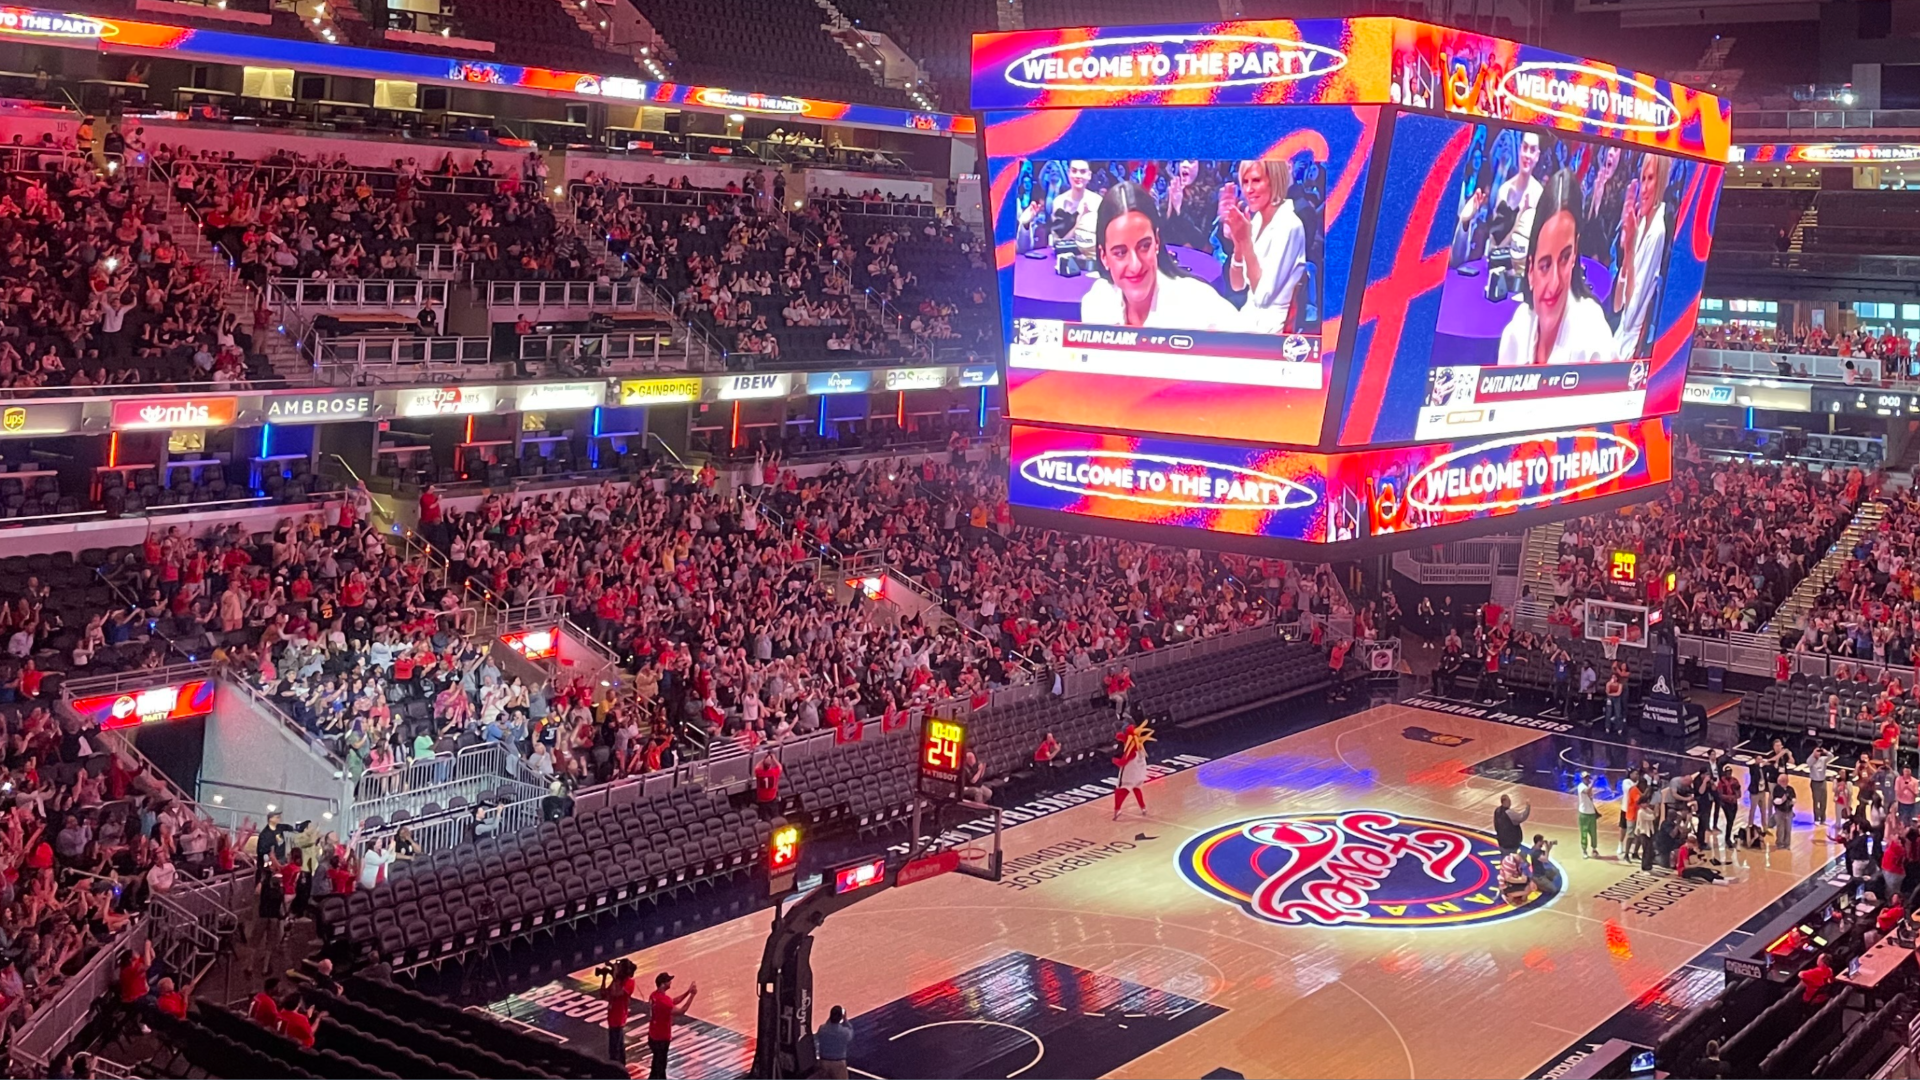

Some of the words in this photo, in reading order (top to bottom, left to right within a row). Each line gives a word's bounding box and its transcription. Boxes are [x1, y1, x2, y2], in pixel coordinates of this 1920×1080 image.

[20, 15, 51, 30] THE
[53, 18, 103, 35] PARTY
[1023, 54, 1133, 80] WELCOME
[1140, 54, 1170, 77] TO
[1175, 52, 1222, 76] THE
[1228, 49, 1319, 76] PARTY
[704, 92, 746, 106] WELCOME
[747, 97, 760, 107] TO
[760, 98, 776, 109] THE
[777, 101, 803, 111] PARTY
[1515, 72, 1590, 107] WELCOME
[1591, 88, 1609, 112] TO
[1609, 93, 1635, 119] THE
[1633, 99, 1671, 127] PARTY
[1807, 149, 1855, 158] WELCOME
[1857, 149, 1870, 159] TO
[1872, 149, 1892, 159] THE
[1067, 328, 1102, 344] CAITLIN
[1103, 330, 1138, 346] CLARK
[733, 375, 777, 390] IBEW
[827, 372, 852, 393] Kroger
[888, 370, 915, 386] aes
[1480, 376, 1509, 394] CAITLIN
[1509, 373, 1540, 391] CLARK
[434, 389, 456, 401] the
[639, 383, 698, 398] GAINBRIDGE
[1684, 388, 1709, 397] TION
[1711, 389, 1728, 400] 127
[268, 398, 368, 415] AMBROSE
[5, 413, 24, 428] ups
[1426, 463, 1523, 500] WELCOME
[1525, 457, 1549, 486] TO
[1550, 453, 1581, 481] THE
[1581, 445, 1626, 478] PARTY
[1036, 459, 1134, 489] WELCOME
[1137, 472, 1165, 492] TO
[1170, 474, 1212, 497] THE
[1214, 478, 1292, 507] PARTY
[1613, 561, 1634, 580] 24
[142, 711, 168, 723] PARTY
[1401, 697, 1488, 717] INDIANA
[1487, 712, 1574, 732] PACERS
[1643, 704, 1677, 716] Ascension
[932, 721, 961, 742] 10:00
[928, 737, 957, 768] 24
[1162, 753, 1210, 773] WE
[764, 777, 769, 789] 1
[932, 770, 957, 782] TISSOT
[959, 782, 1102, 837] BASKETBALL
[775, 844, 792, 863] 24
[997, 841, 1137, 891] GAINBRIDGE
[1253, 812, 1473, 922] Fever
